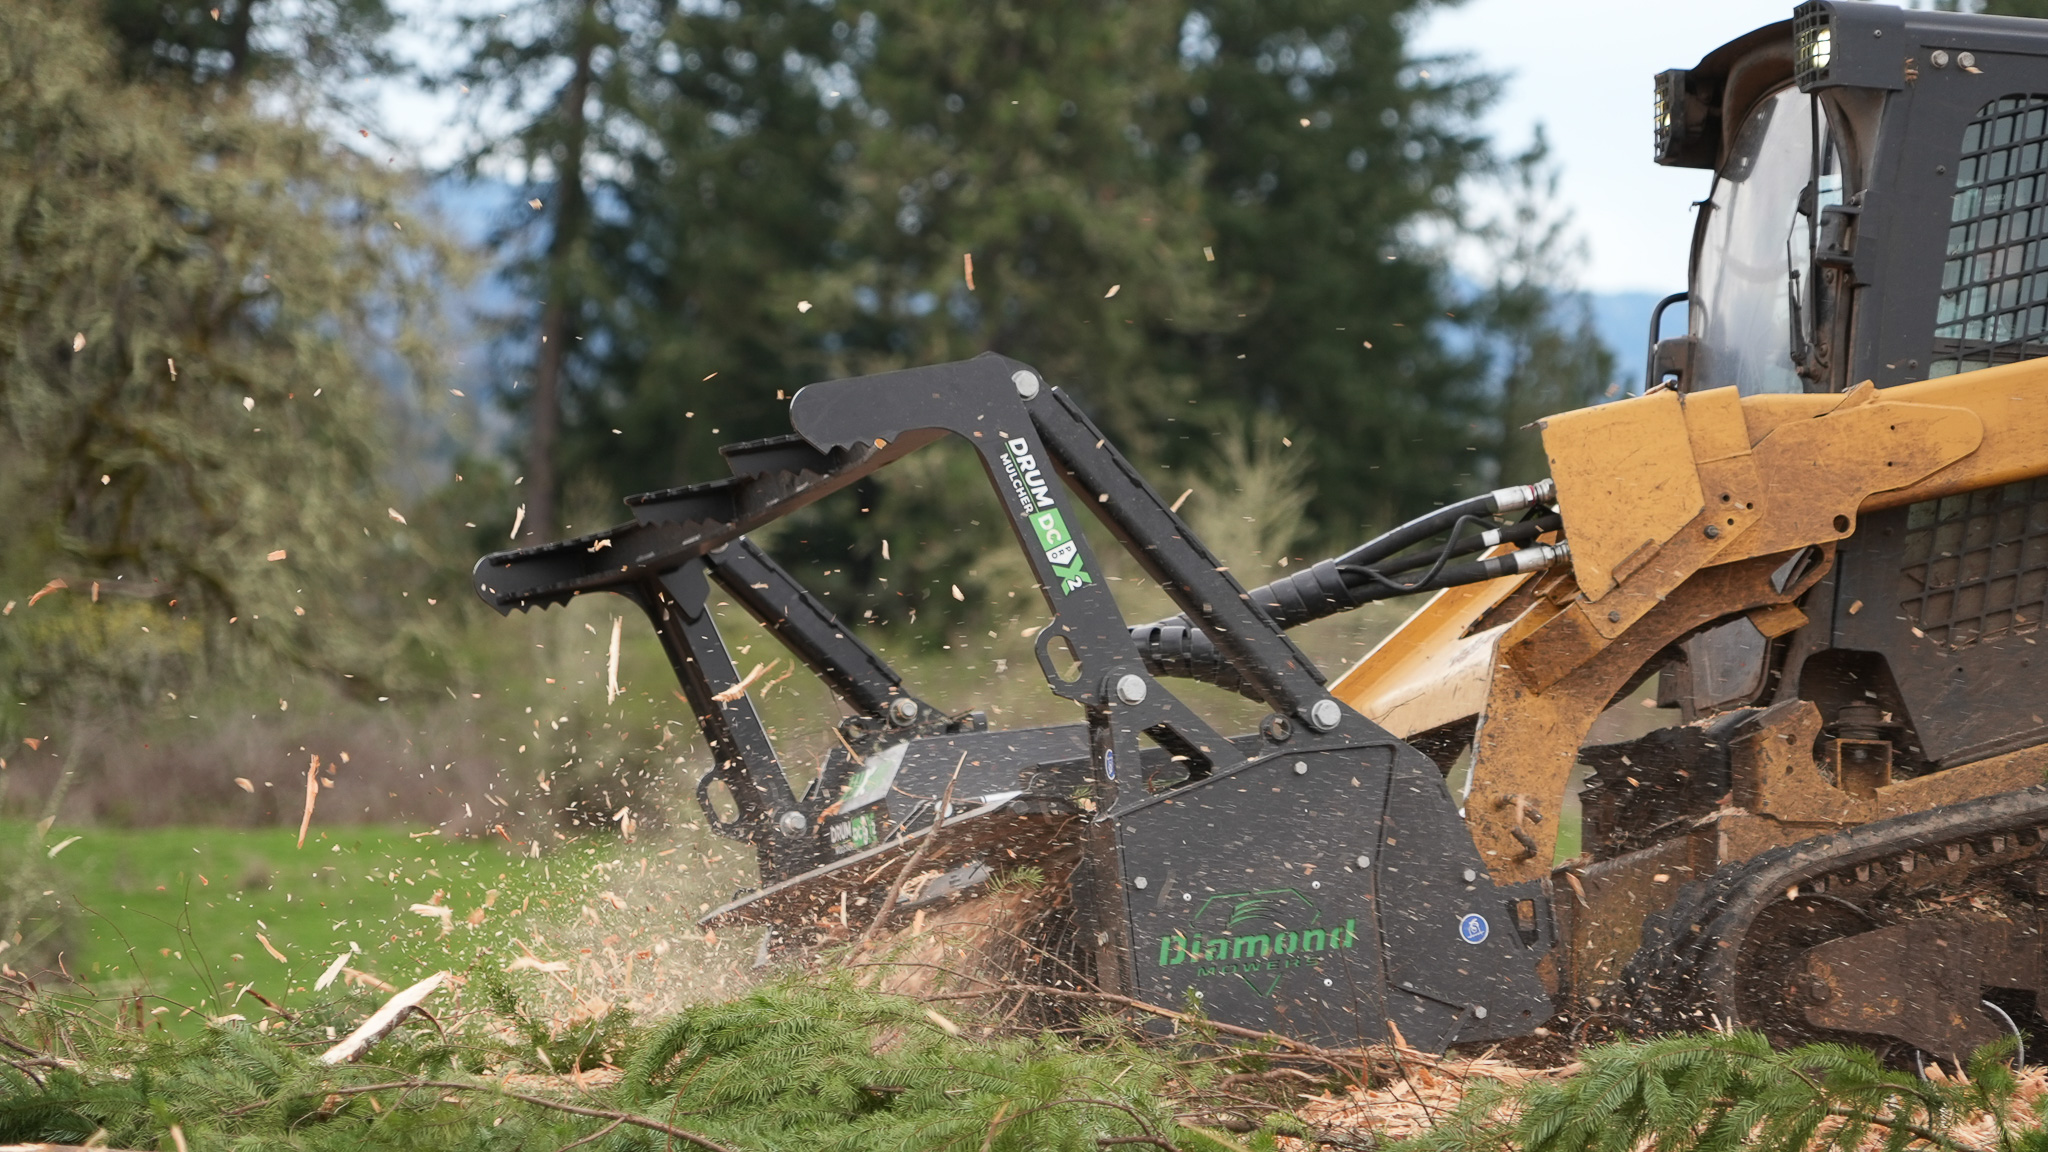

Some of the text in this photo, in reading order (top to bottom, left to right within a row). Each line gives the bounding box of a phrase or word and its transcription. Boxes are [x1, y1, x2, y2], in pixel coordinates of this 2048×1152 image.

[999, 452, 1034, 514] MULCHER
[1007, 437, 1055, 508] DRUM
[1037, 512, 1062, 545] DC
[1051, 545, 1073, 559] PRO
[1159, 918, 1356, 967] Diamond
[1197, 956, 1320, 977] MOWERS
